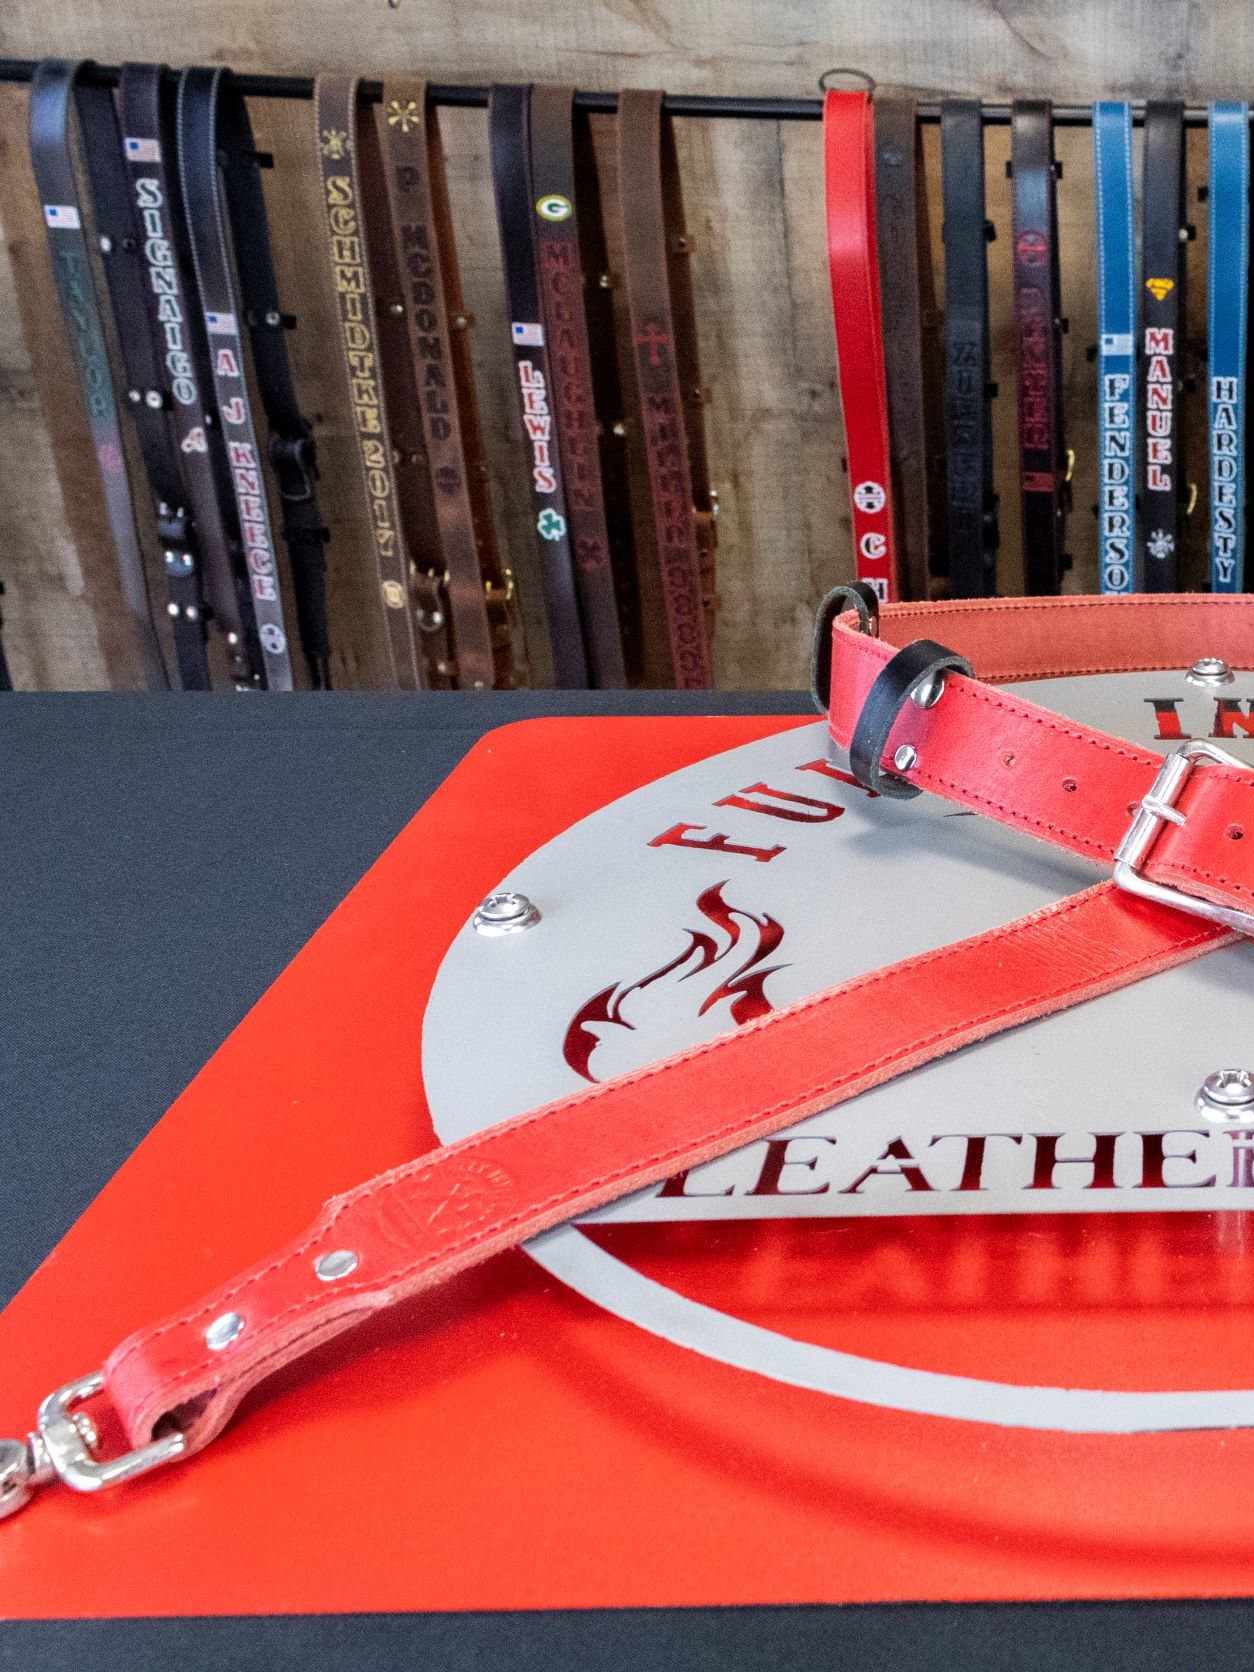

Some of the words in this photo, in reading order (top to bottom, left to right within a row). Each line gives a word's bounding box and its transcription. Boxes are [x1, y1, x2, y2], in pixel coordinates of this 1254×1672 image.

[135, 177, 198, 406] SIGNAIGO
[217, 349, 239, 377] A
[326, 175, 381, 434] SCHMIDTKE
[401, 223, 452, 442] MCDONALD
[543, 241, 595, 510] MCLAUGHLIN
[222, 397, 246, 424] J
[518, 360, 557, 493] LEWIS
[1103, 373, 1130, 595] FENDERSO
[1145, 328, 1174, 491] MANUEL
[1212, 376, 1238, 583] HARDESTY
